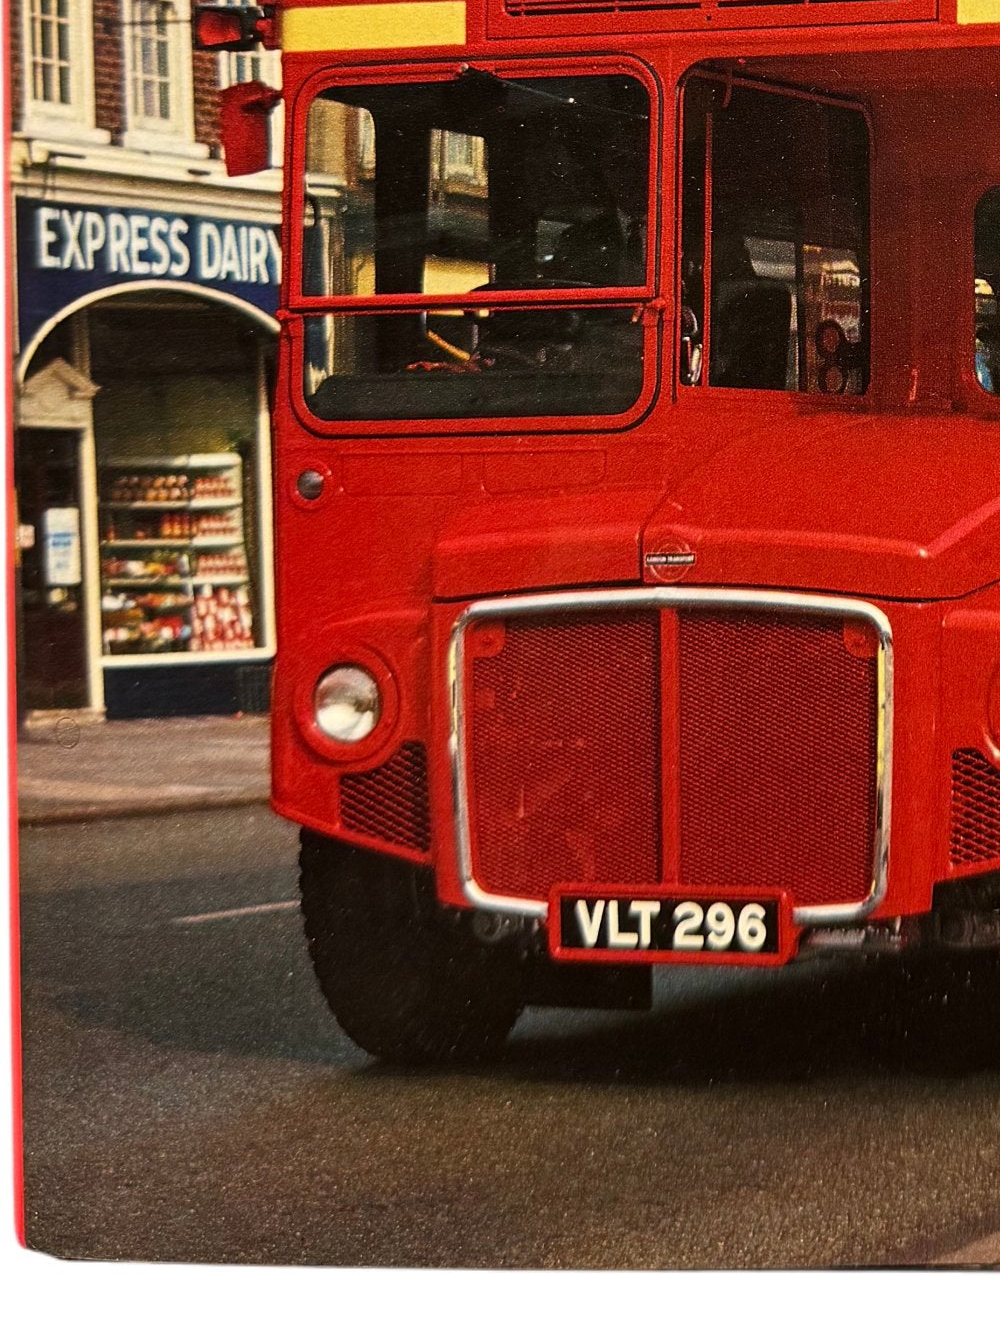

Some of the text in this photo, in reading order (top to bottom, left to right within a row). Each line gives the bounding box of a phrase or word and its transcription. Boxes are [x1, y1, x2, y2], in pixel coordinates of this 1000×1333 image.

[37, 206, 191, 278] EXPRESS
[575, 899, 767, 952] VLT 296
